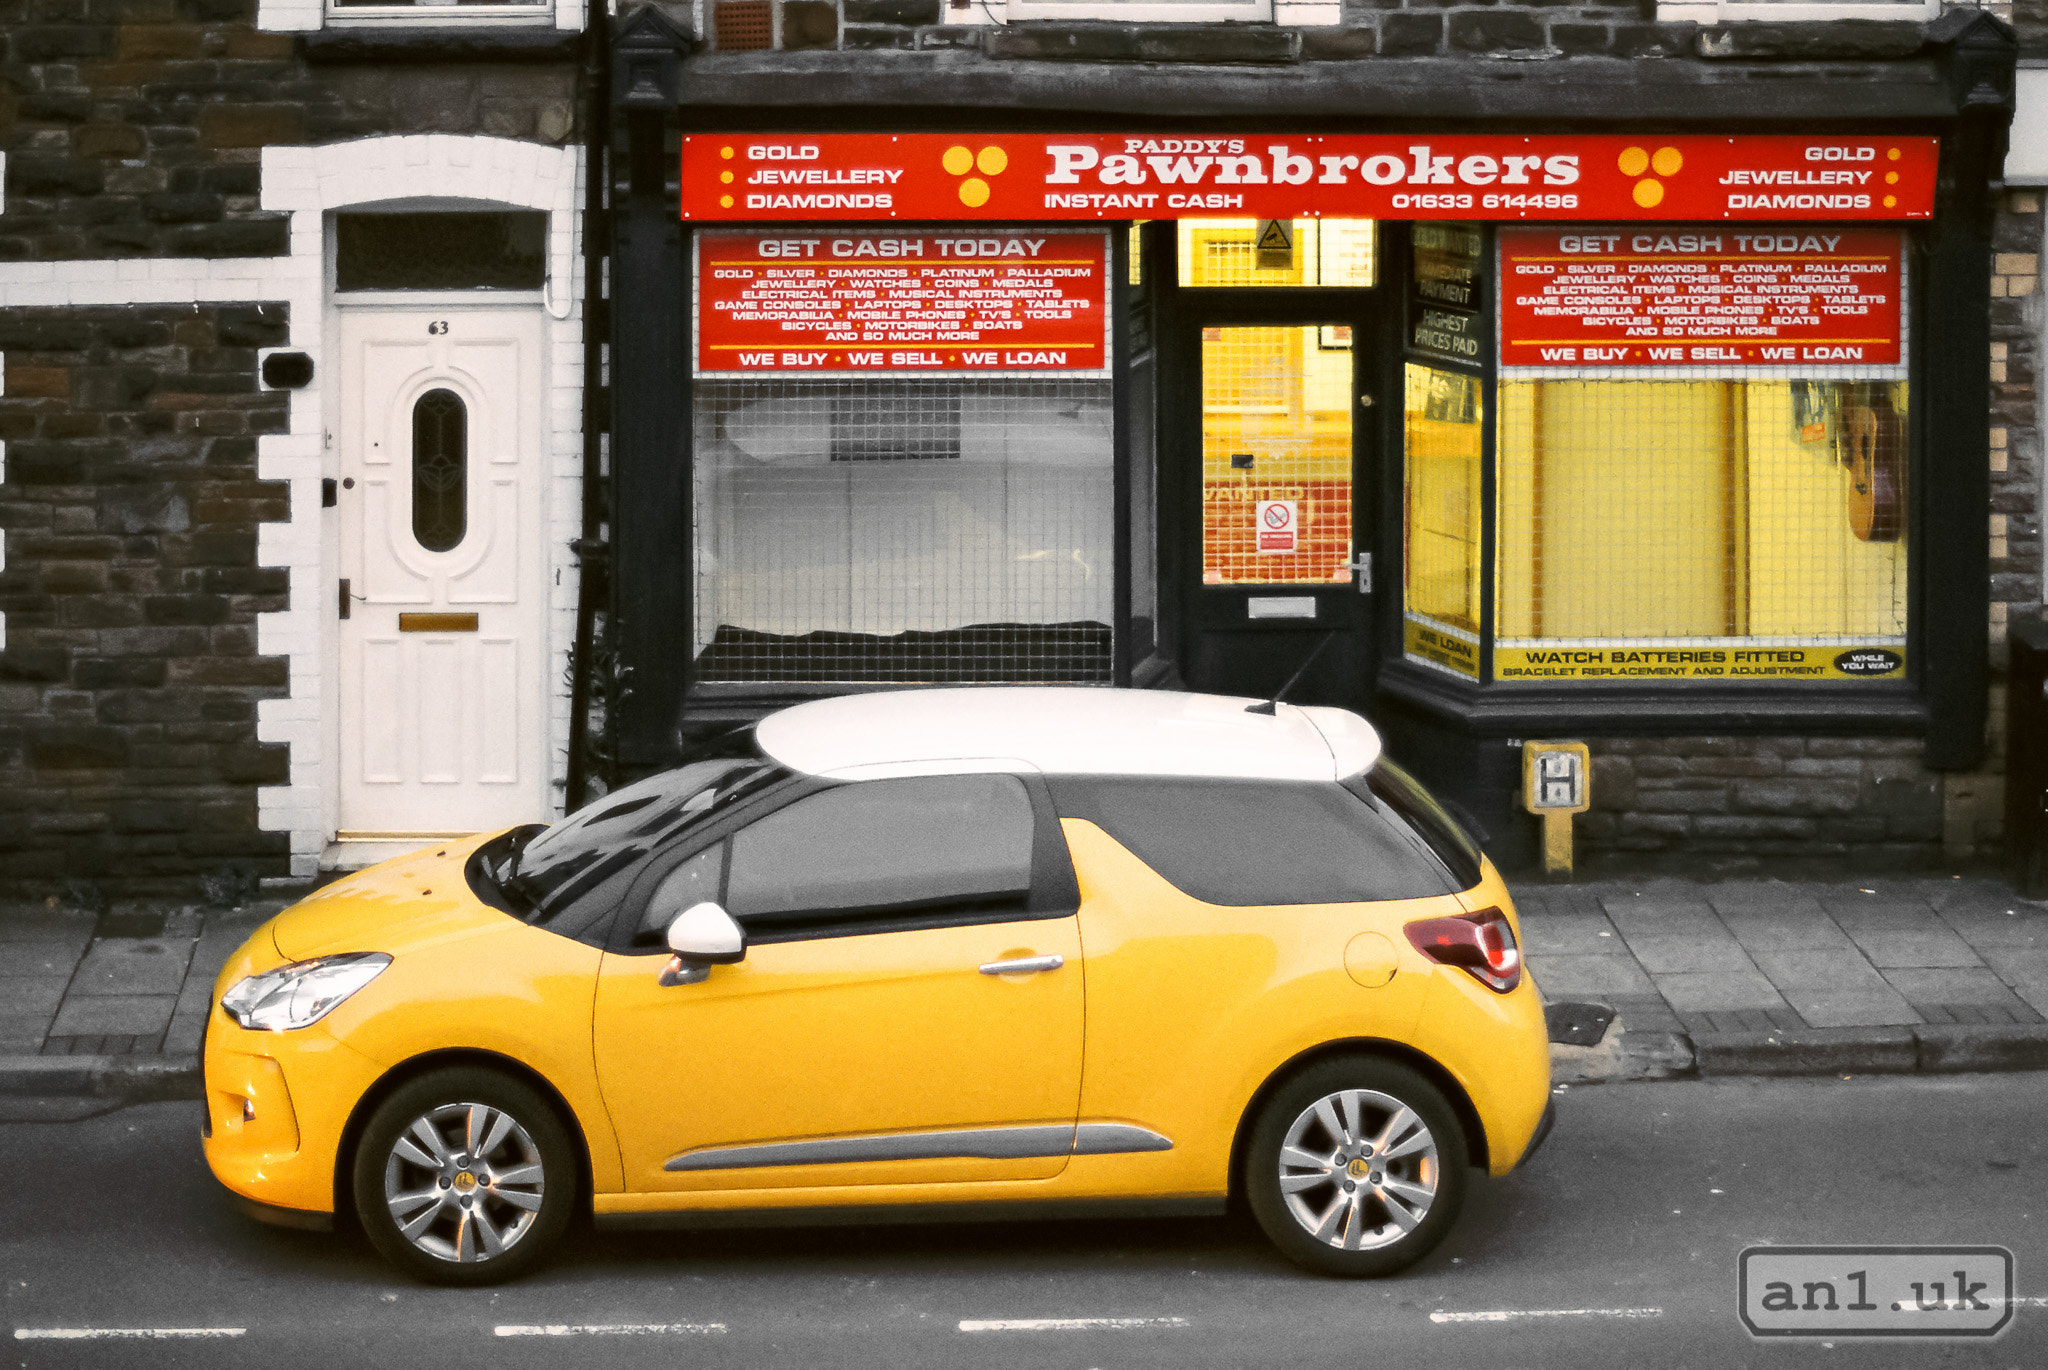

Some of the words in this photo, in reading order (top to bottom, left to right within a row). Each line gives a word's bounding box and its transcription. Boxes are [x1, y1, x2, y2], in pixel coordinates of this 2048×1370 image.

[747, 146, 818, 160] GOLD
[1125, 140, 1244, 153] PADDY'S
[1805, 148, 1874, 160] GOLD
[1045, 145, 1580, 186] Pawnbrokers
[747, 170, 904, 184] JEWELLERY
[1719, 171, 1872, 184] JEWELLERY
[747, 194, 892, 208] DIAMONDS
[1045, 194, 1158, 208] INSTANT
[1168, 194, 1243, 208] CASH
[1392, 195, 1473, 208] 01633
[1482, 195, 1578, 208] 614496
[1728, 195, 1870, 208] DIAMONDS
[758, 240, 820, 257] GET
[832, 240, 923, 257] CASH
[936, 240, 1045, 257] TODAY
[1559, 236, 1620, 253] GET
[1632, 236, 1722, 252] CASH
[1734, 236, 1840, 252] TODAY
[714, 270, 753, 278] GOLD
[766, 269, 815, 278] SILVER
[828, 269, 908, 278] DIAMONDS
[922, 269, 994, 277] PLATINUM
[1007, 268, 1091, 277] PALLADIUM
[1516, 265, 1554, 274] GOLD
[1568, 265, 1615, 273] SILVER
[1628, 265, 1707, 273] DIAMONDS
[1720, 265, 1792, 273] PLATINUM
[1805, 265, 1886, 273] PALLADIUM
[751, 280, 835, 289] JEWELLERY
[850, 280, 920, 288] WATCHES
[935, 279, 979, 288] COINS
[993, 279, 1053, 288] MEDALS
[1552, 275, 1636, 284] JEWELLERY
[1650, 275, 1720, 283] WATCHES
[1733, 275, 1777, 283] COINS
[1790, 275, 1850, 283] MEDALS
[833, 290, 876, 298] ITEMS
[889, 290, 954, 298] MUSICAL
[958, 290, 1062, 298] INSTRUMENTS
[1419, 279, 1471, 304] PAYMENT
[1544, 286, 1628, 294] ELECTRICAL
[1633, 286, 1675, 294] ITEMS
[1688, 286, 1753, 294] MUSICAL
[1757, 286, 1858, 294] INSTRUMENTS
[714, 301, 759, 309] GAME
[763, 301, 841, 309] CONSOLES
[854, 301, 921, 309] LAPTOPS
[935, 300, 1013, 309] DESKTOPS
[1026, 300, 1090, 308] TABLETS
[1516, 296, 1560, 305] GAME
[1564, 296, 1641, 305] CONSOLES
[1654, 296, 1720, 304] LAPTOPS
[1733, 296, 1810, 304] DESKTOPS
[1823, 296, 1886, 304] TABLETS
[732, 311, 834, 320] MEMORABILIA
[847, 311, 902, 320] MOBILE
[906, 311, 965, 319] PHONES
[979, 311, 1012, 319] TV'S
[1024, 310, 1071, 319] TOOLS
[1534, 307, 1634, 315] MEMORABILIA
[1647, 307, 1700, 315] MOBILE
[1705, 307, 1764, 315] PHONES
[1777, 306, 1809, 314] TV'S
[1821, 306, 1868, 314] TOOLS
[782, 322, 851, 330] BICYCLES
[865, 322, 960, 330] MOTORBIKES
[973, 321, 1022, 329] BOATS
[1423, 309, 1468, 332] HIGHEST
[1583, 317, 1651, 325] BICYCLES
[1664, 317, 1758, 325] MOTORBIKES
[1771, 317, 1819, 325] BOATS
[428, 321, 449, 334] 63
[1626, 327, 1659, 336] AND
[1662, 327, 1684, 336] SO
[1688, 327, 1732, 335] MUCH
[1735, 327, 1777, 335] MORE
[825, 332, 859, 340] AND
[863, 332, 884, 340] SO
[888, 332, 933, 340] MUCH
[937, 332, 979, 340] MORE
[1415, 328, 1450, 350] PRICES
[1452, 336, 1478, 356] PAID
[739, 353, 774, 365] WE
[782, 353, 828, 365] BUY
[848, 353, 883, 365] WE
[892, 353, 943, 364] SELL
[963, 353, 998, 364] WE
[1006, 352, 1066, 364] LOAN
[1540, 348, 1575, 360] WE
[1583, 348, 1628, 360] BUY
[1648, 348, 1682, 360] WE
[1691, 348, 1741, 360] SELL
[1761, 348, 1795, 359] WE
[1803, 348, 1862, 359] LOAN
[1419, 629, 1437, 644] WE
[1440, 637, 1471, 658] LOAN
[1526, 652, 1602, 664] WATCH
[1612, 652, 1726, 664] BATTERIES
[1734, 651, 1804, 663] FITTED
[1503, 668, 1578, 676] BRACELET
[1582, 667, 1689, 676] REPLACEMENT
[1694, 667, 1725, 676] AND
[1729, 666, 1826, 675] ADJUSTMENT
[1842, 662, 1865, 670] YOU
[1541, 759, 1575, 802] H
